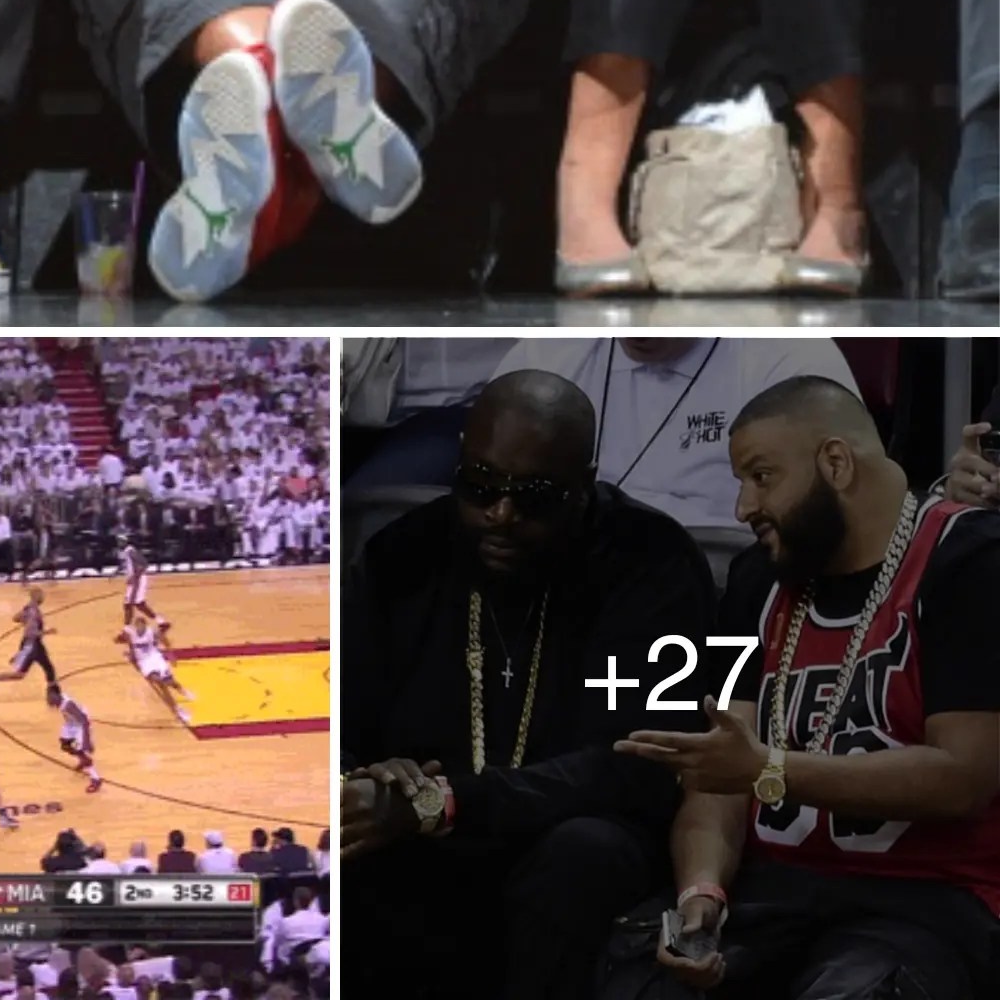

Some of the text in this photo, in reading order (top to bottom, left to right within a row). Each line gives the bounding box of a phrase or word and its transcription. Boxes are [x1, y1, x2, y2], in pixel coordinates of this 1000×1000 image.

[756, 611, 912, 748] HEAT
[6, 884, 46, 902] MIA
[66, 881, 104, 904] 46
[172, 884, 214, 901] 3:52
[230, 886, 248, 900] 21
